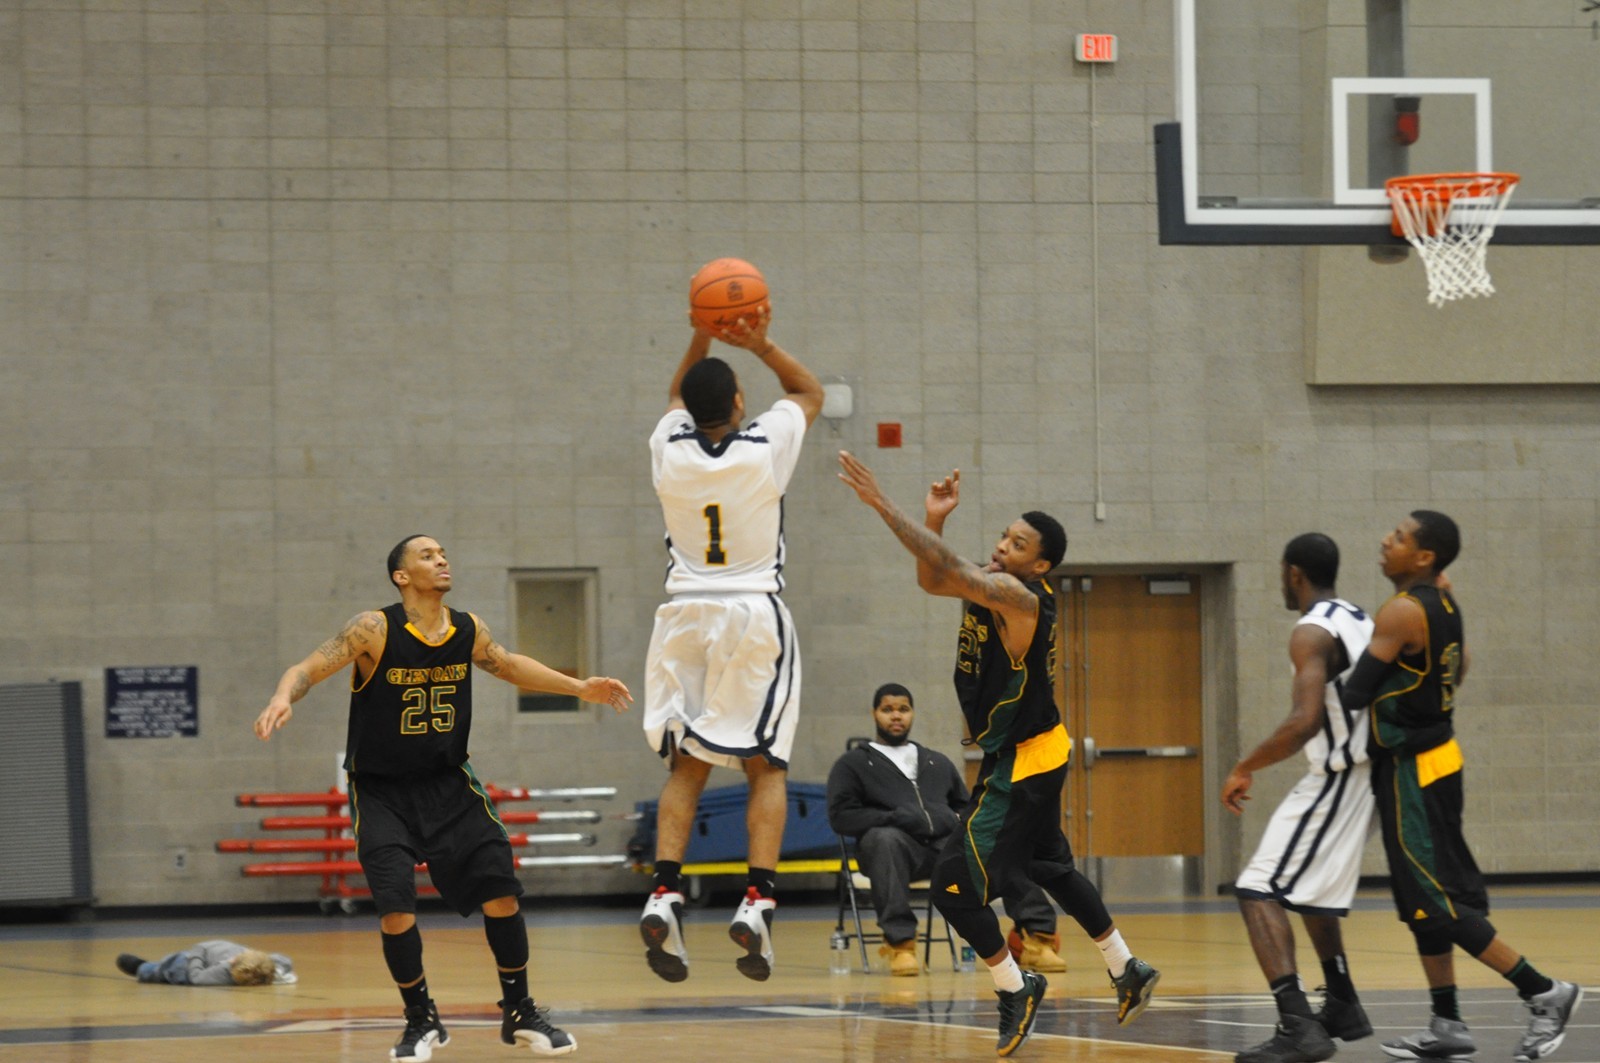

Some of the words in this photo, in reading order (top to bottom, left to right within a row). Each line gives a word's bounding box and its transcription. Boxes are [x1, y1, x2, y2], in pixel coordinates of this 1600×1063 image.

[1082, 34, 1113, 61] EXIT
[702, 503, 728, 567] 1
[386, 667, 431, 685] GLEN
[400, 685, 456, 735] 25
